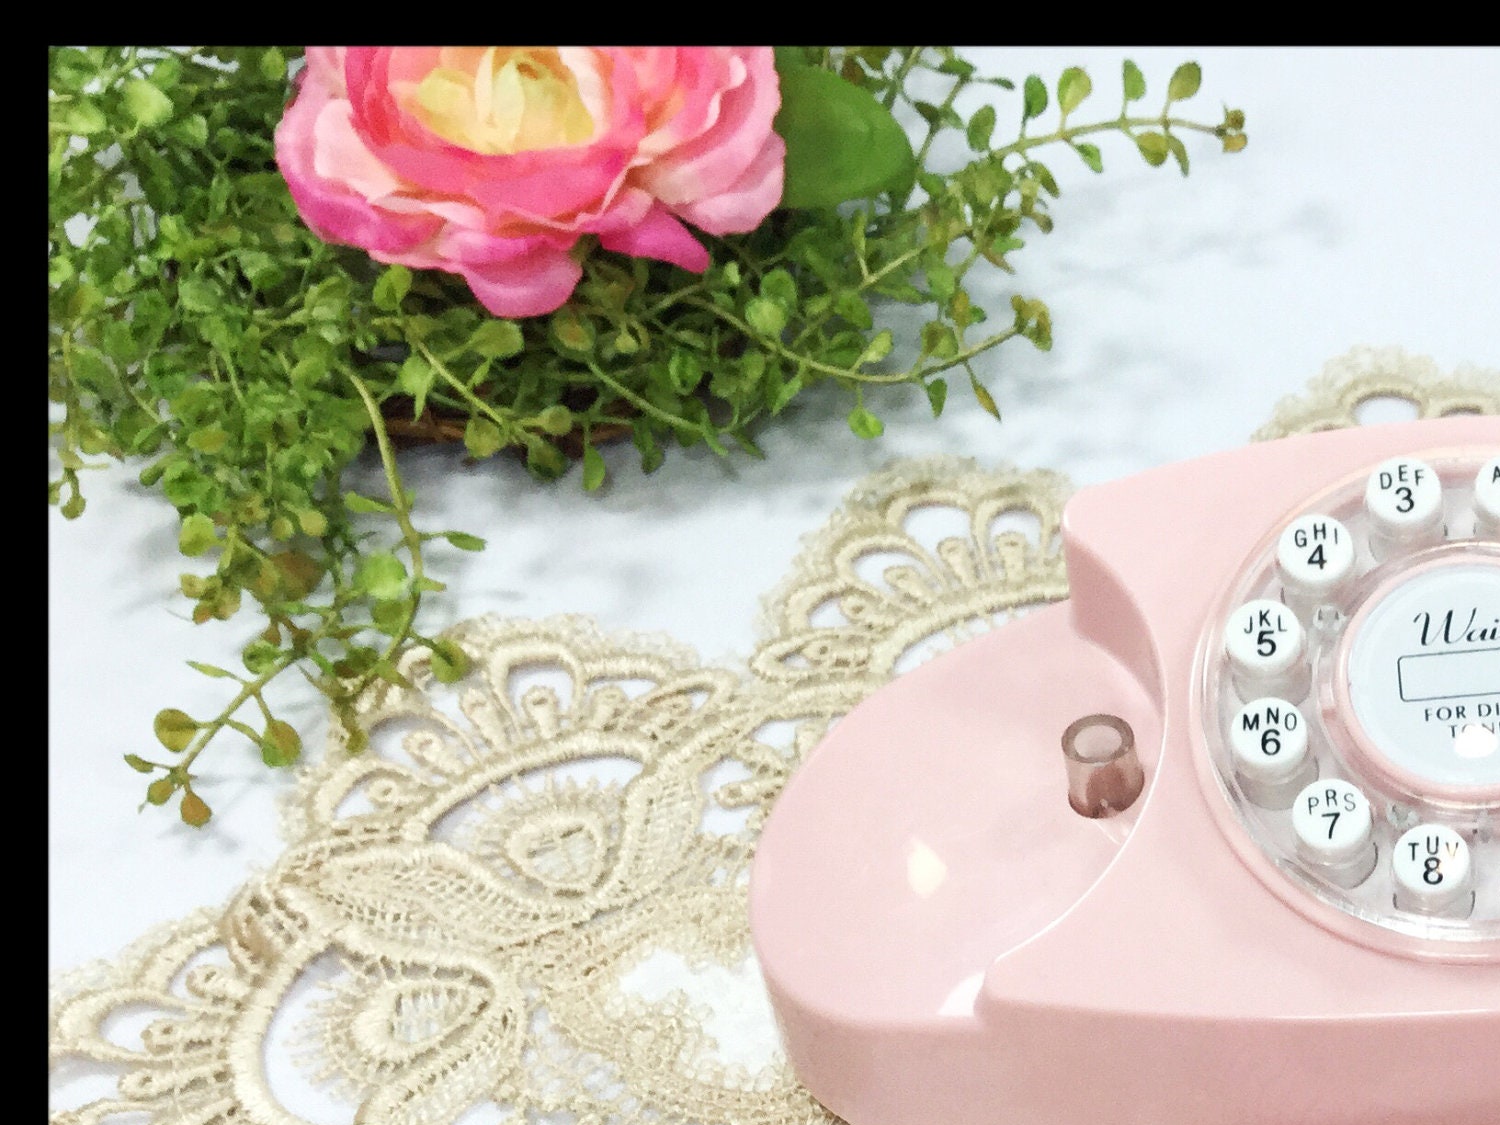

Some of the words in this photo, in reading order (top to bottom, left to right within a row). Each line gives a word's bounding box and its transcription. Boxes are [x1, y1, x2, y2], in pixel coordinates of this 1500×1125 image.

[1380, 464, 1425, 490] DEF
[1395, 487, 1415, 514] 3
[1294, 522, 1340, 549] GHI
[1306, 544, 1328, 571] 4
[1243, 609, 1288, 635] JKL
[1255, 631, 1278, 658] 5
[1242, 707, 1298, 733] MNO
[1424, 705, 1467, 722] FOR
[1260, 729, 1282, 757] 6
[1307, 788, 1357, 815] PRS
[1321, 811, 1341, 840] 7
[1407, 836, 1461, 863] TUV
[1422, 857, 1444, 886] 8
